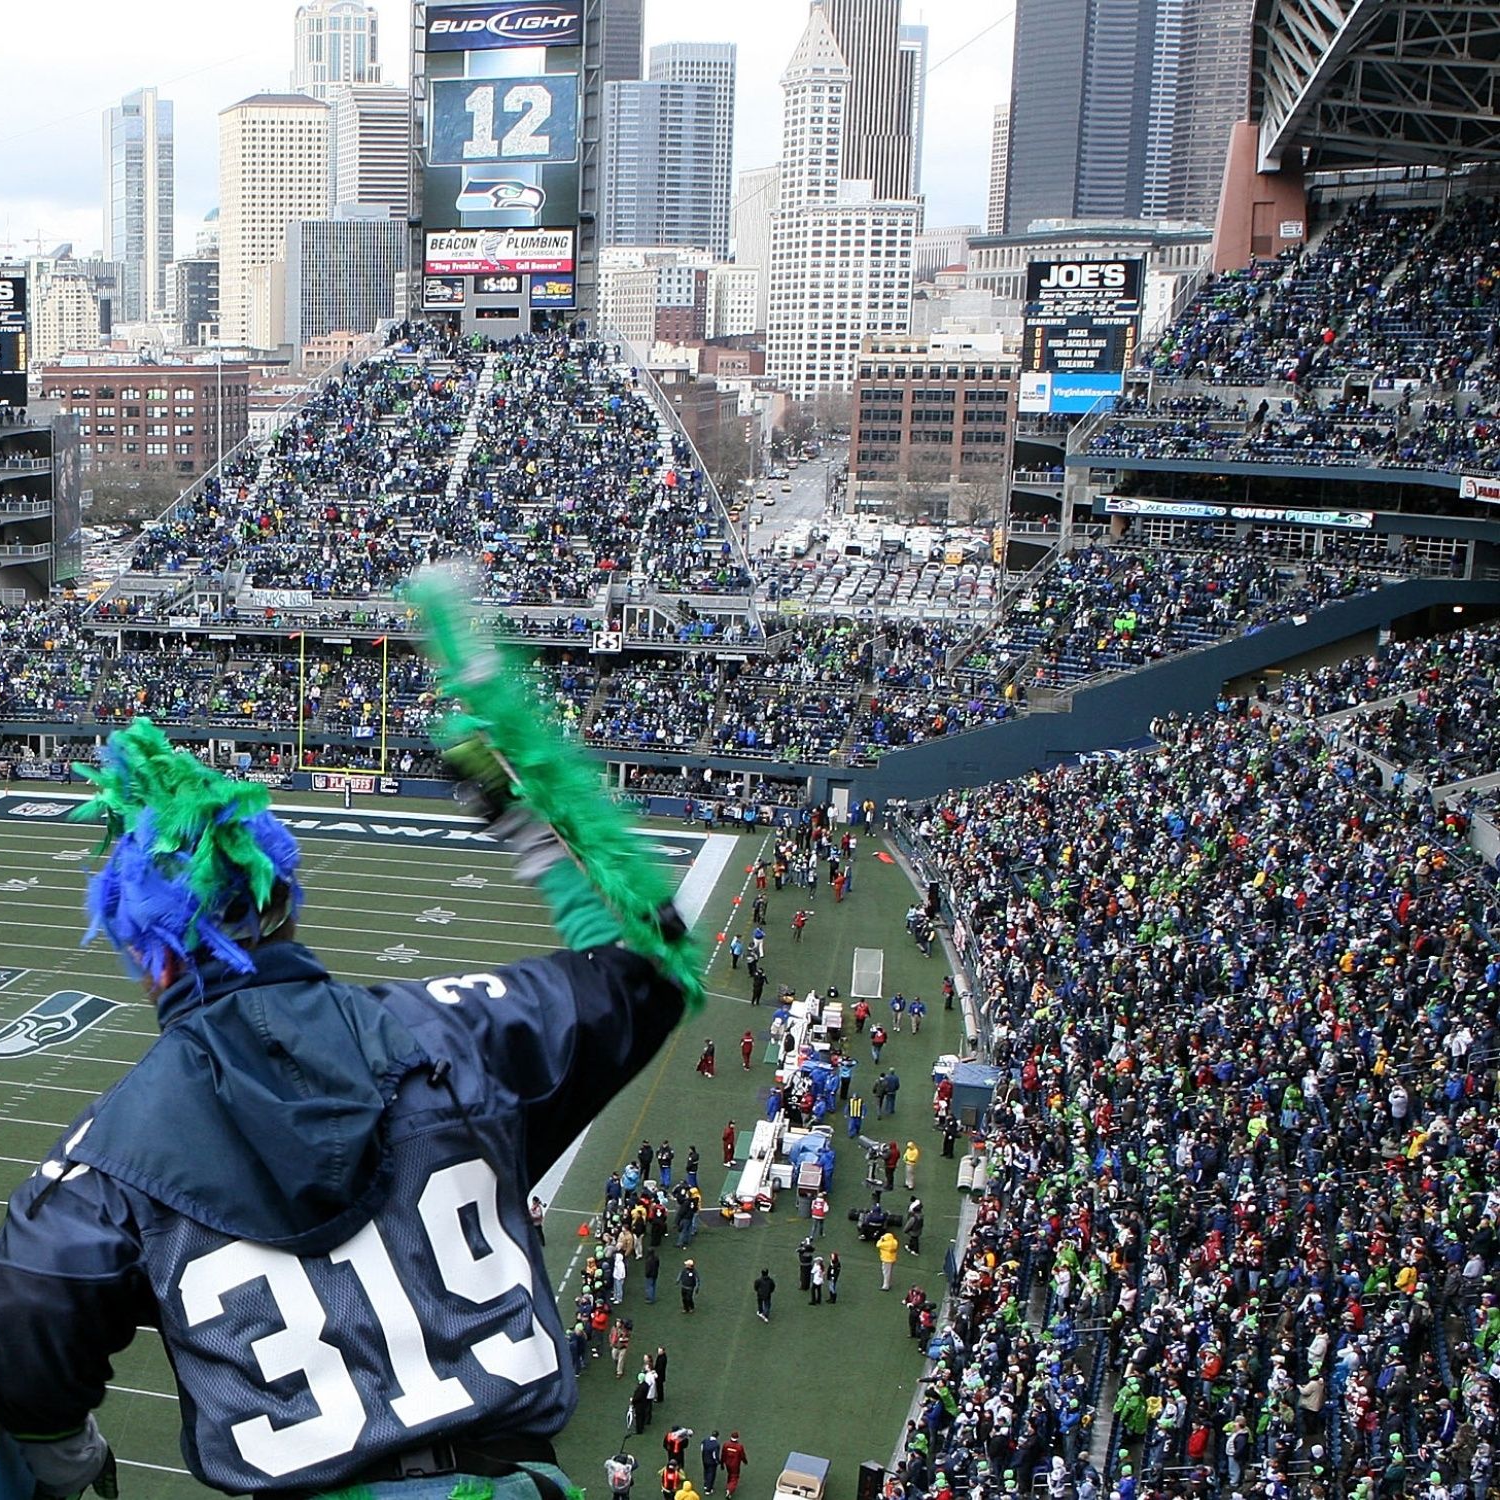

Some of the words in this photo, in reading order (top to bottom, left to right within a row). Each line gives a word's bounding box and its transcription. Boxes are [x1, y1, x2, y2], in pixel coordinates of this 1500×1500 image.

[429, 20, 487, 34] BUD
[500, 15, 578, 30] LIGHT
[463, 85, 551, 159] 12
[430, 237, 478, 250] BEACON
[506, 236, 569, 249] PLUMBING
[1040, 264, 1125, 288] JOE'S
[484, 277, 518, 291] 15:00
[1042, 304, 1116, 312] DEFENSE
[1027, 318, 1067, 326] SEAHAWKS
[1092, 317, 1131, 325] VISITORS
[1141, 504, 1204, 515] WELCOME
[1208, 506, 1226, 516] TO
[1231, 507, 1286, 519] QWEST
[1286, 511, 1332, 522] FIELD
[290, 590, 312, 606] NEST
[598, 633, 617, 648] 25
[356, 726, 371, 738] 12
[329, 777, 371, 790] PLAOFFS
[272, 818, 513, 843] HAWK
[178, 1157, 558, 1477] 319
